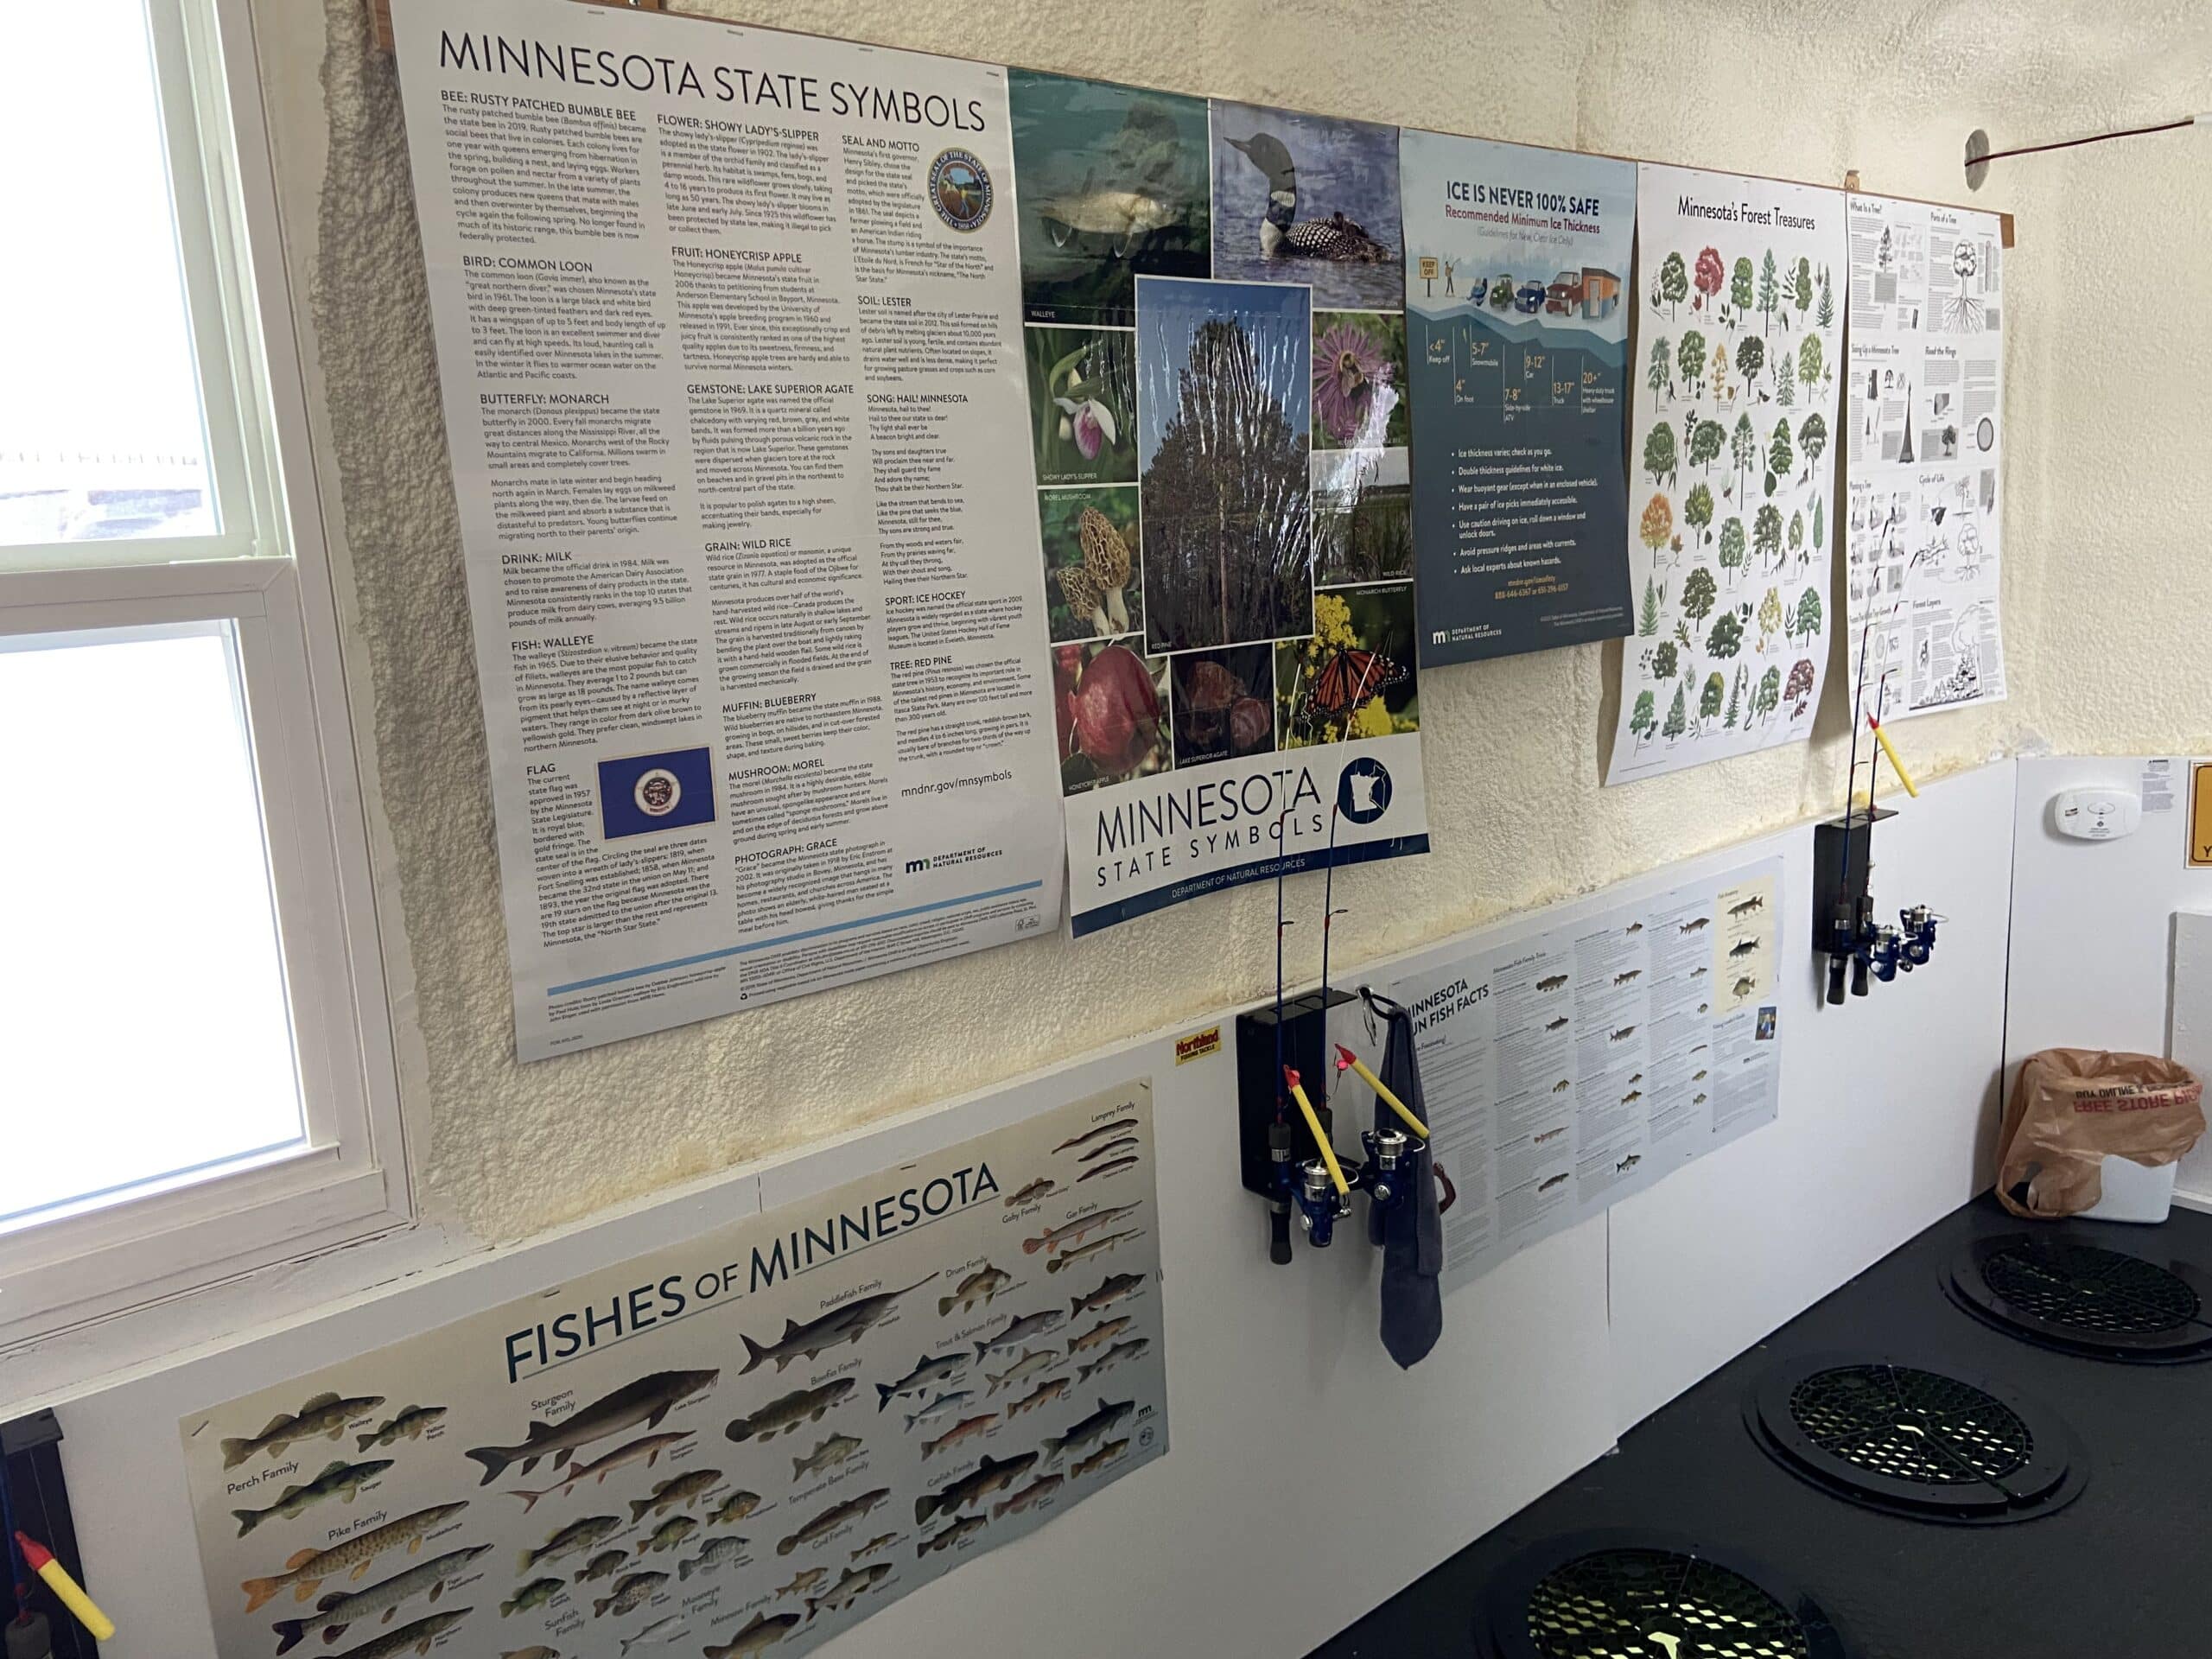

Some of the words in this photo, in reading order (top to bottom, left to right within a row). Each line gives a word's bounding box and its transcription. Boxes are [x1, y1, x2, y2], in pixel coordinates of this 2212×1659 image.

[441, 30, 706, 99] MINNESOTA
[714, 67, 821, 111] STATE
[831, 81, 986, 132] SYMBOLS
[441, 90, 467, 103] BEE:
[470, 92, 509, 106] RUSTY
[512, 97, 565, 113] PATCHED
[568, 104, 613, 119] BUMBLE
[615, 109, 637, 122] BEE
[657, 113, 702, 129] FLOWER:
[704, 119, 742, 133] SHOWY
[745, 124, 819, 142] LADY'S-SLIPPER
[842, 135, 865, 147] SEAL
[866, 137, 887, 149] AND
[888, 140, 920, 152] MOTTO
[1446, 181, 1470, 201] ICE
[1473, 184, 1486, 203] IS
[1489, 187, 1534, 209] NEVER
[1536, 193, 1567, 213] 100%
[1569, 196, 1599, 217] SAFE
[1445, 205, 1510, 224] Recommended
[1511, 213, 1548, 228] Minimum
[1550, 216, 1562, 230] Ice
[1562, 218, 1600, 234] Thickness
[1678, 195, 1738, 221] Minnesota's
[1741, 202, 1771, 226] Forest
[1774, 207, 1815, 230] Treasures
[462, 255, 496, 268] BIRD:
[498, 257, 556, 270] COMMON
[559, 260, 593, 273] LOON
[671, 245, 703, 258] FRUIT:
[705, 249, 771, 262] HONEYCRISP
[772, 252, 803, 264] APPLE
[857, 295, 880, 306] SOIL:
[881, 296, 912, 308] LESTER
[1031, 310, 1056, 319] WALLEYE
[480, 393, 546, 404] BUTTERFLY:
[549, 393, 609, 404] MONARCH
[686, 384, 746, 394] GEMSTONE:
[747, 384, 773, 394] LAKE
[774, 384, 823, 394] SUPERIOR
[824, 384, 855, 394] AGATE
[867, 393, 895, 404] SONG:
[896, 394, 918, 404] HAIL!
[920, 394, 969, 404] MINNESOTA
[1458, 448, 1467, 458] Ice
[1467, 448, 1493, 458] thickness
[1493, 448, 1511, 457] varies;
[1510, 447, 1527, 456] check
[1533, 448, 1543, 458] you
[1543, 448, 1553, 458] go.
[1458, 466, 1478, 476] Double
[1478, 466, 1504, 475] thickness
[1504, 464, 1531, 476] guidelines
[1531, 463, 1540, 473] for
[1539, 463, 1554, 472] white
[1554, 463, 1564, 472] ice.
[704, 541, 741, 552] GRAIN:
[741, 539, 767, 550] WILD
[768, 537, 791, 549] RICE
[501, 553, 543, 565] DRINK:
[545, 551, 573, 563] MILK
[885, 594, 915, 607] SPORT:
[916, 594, 931, 603] ICE
[931, 590, 966, 602] HOCKEY
[1452, 625, 1482, 635] DEPARTMENT
[1475, 629, 1502, 639] RESOURCES
[511, 639, 542, 652] FISH:
[543, 634, 594, 648] WALLEYE
[889, 660, 913, 671] TREE:
[914, 658, 931, 668] RED
[932, 655, 953, 666] PINE
[722, 700, 763, 714] MUFFIN:
[764, 693, 817, 708] BLUEBERRY
[526, 763, 556, 776] FLAG
[542, 773, 570, 784] current
[728, 764, 791, 781] MUSHROOM:
[792, 758, 825, 771] MOREL
[528, 787, 548, 796] state
[548, 785, 563, 793] flag
[563, 783, 579, 792] was
[901, 770, 1012, 797] mndnr.gov/mnsymbols
[529, 790, 564, 807] approved
[564, 788, 574, 800] in
[573, 787, 591, 799] 1957
[1097, 766, 1322, 856] MINNESOTA
[734, 845, 804, 865] PHOTOGRAPH:
[805, 838, 837, 851] GRACE
[933, 849, 976, 862] DEPARTMENT
[933, 858, 963, 868] NATURAL
[965, 849, 1003, 862] RESOURCES
[1097, 846, 1171, 887] STATE
[1190, 813, 1323, 859] SYMBOLS
[1170, 878, 1215, 899] DEPARTMENT
[1215, 875, 1226, 885] OF
[1226, 868, 1259, 881] NATURAL
[1429, 1002, 1454, 1027] FISH
[1457, 984, 1490, 1012] FACTS
[1091, 1109, 1116, 1122] Lamprey
[1116, 1102, 1135, 1114] Family
[1020, 1205, 1041, 1217] Family
[1066, 1210, 1078, 1219] Gar
[1079, 1203, 1097, 1215] Family
[505, 1275, 685, 1383] FISHES
[695, 1263, 739, 1300] OF
[749, 1162, 1000, 1294] MINNESOTA
[945, 1264, 966, 1279] Drum
[966, 1255, 989, 1270] Family
[819, 1288, 858, 1310] Paddlefish
[858, 1279, 882, 1294] Family
[810, 1369, 837, 1389] Bowfin
[837, 1358, 862, 1374] Family
[531, 1389, 574, 1411] Sturgeon
[544, 1401, 576, 1418] Family
[226, 1475, 260, 1495] Perch
[262, 1461, 299, 1482] Family
[327, 1527, 352, 1541] Pike
[353, 1510, 388, 1531] Family
